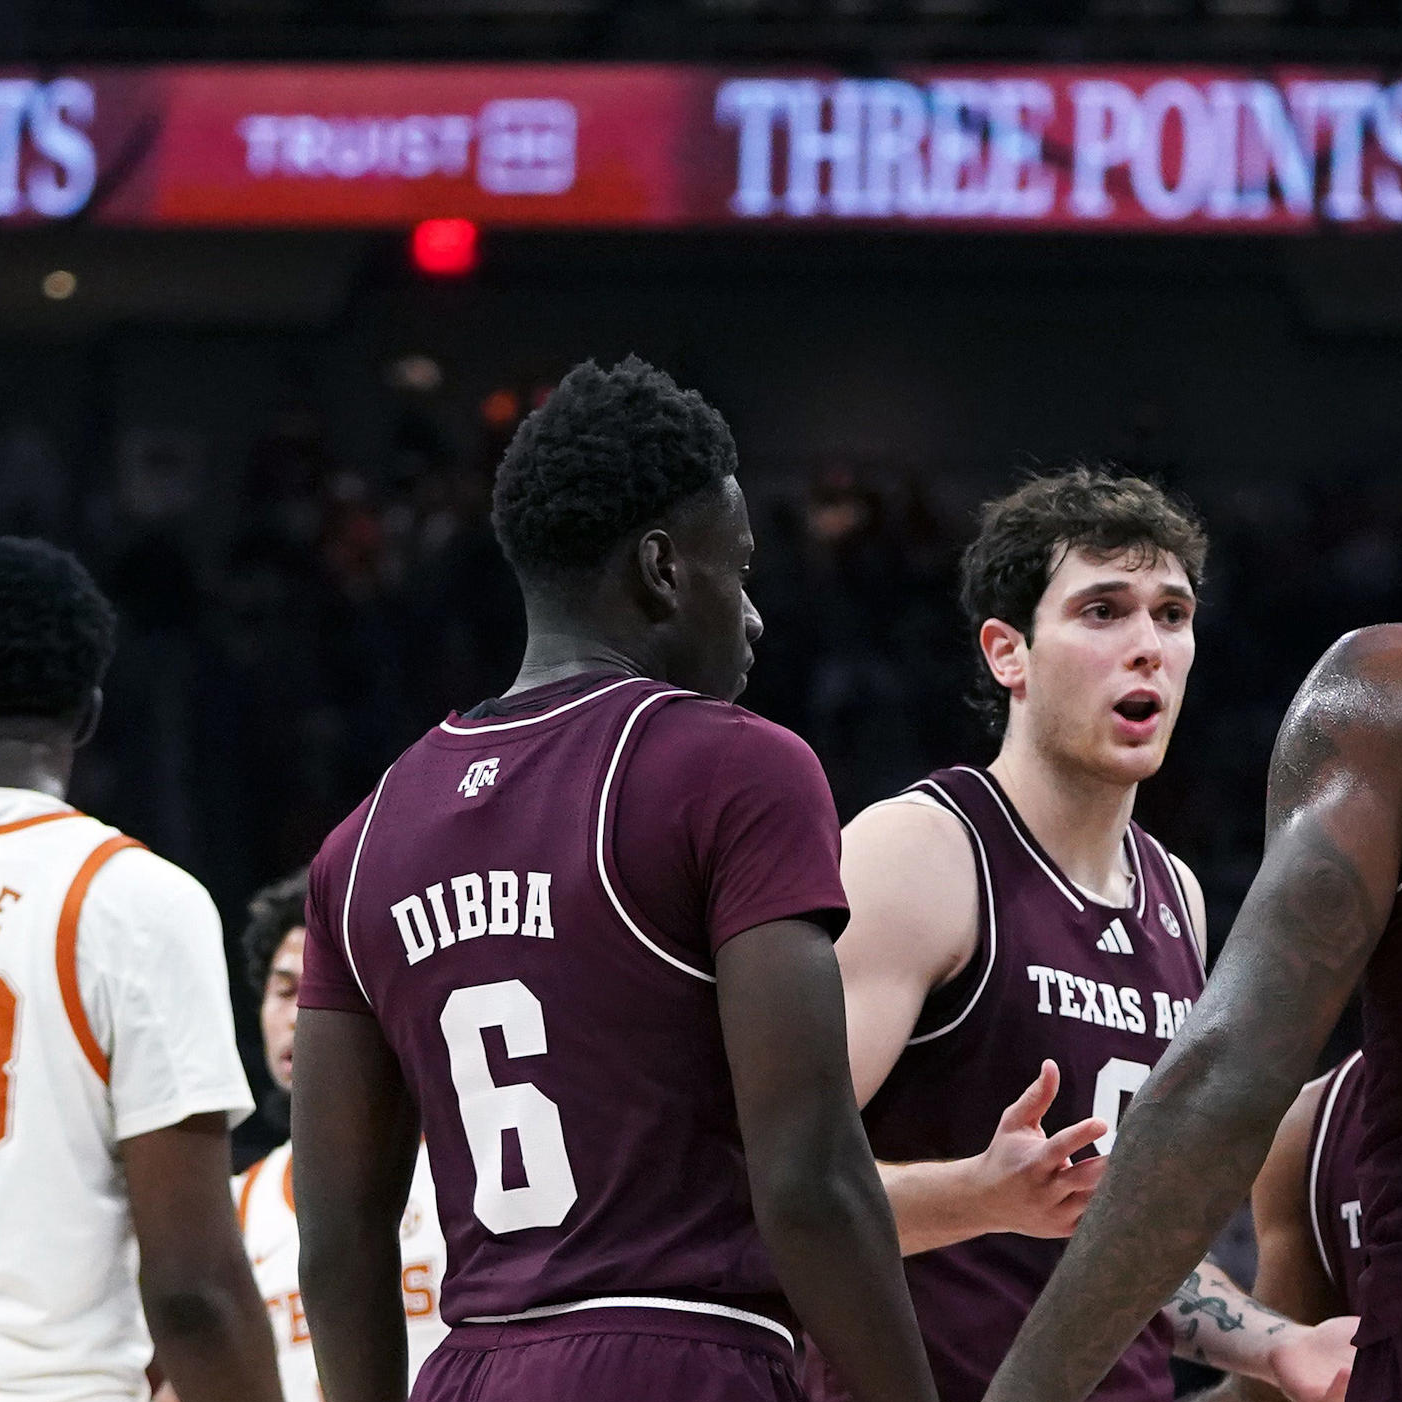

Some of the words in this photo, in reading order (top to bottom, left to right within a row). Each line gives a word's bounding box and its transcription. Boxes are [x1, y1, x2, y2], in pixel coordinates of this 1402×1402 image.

[239, 113, 474, 179] TRUIST
[714, 79, 1057, 218] THREE
[390, 870, 555, 966] DIBBA
[1026, 965, 1147, 1035] TEXAS
[1152, 991, 1193, 1040] A&
[439, 979, 578, 1234] 6
